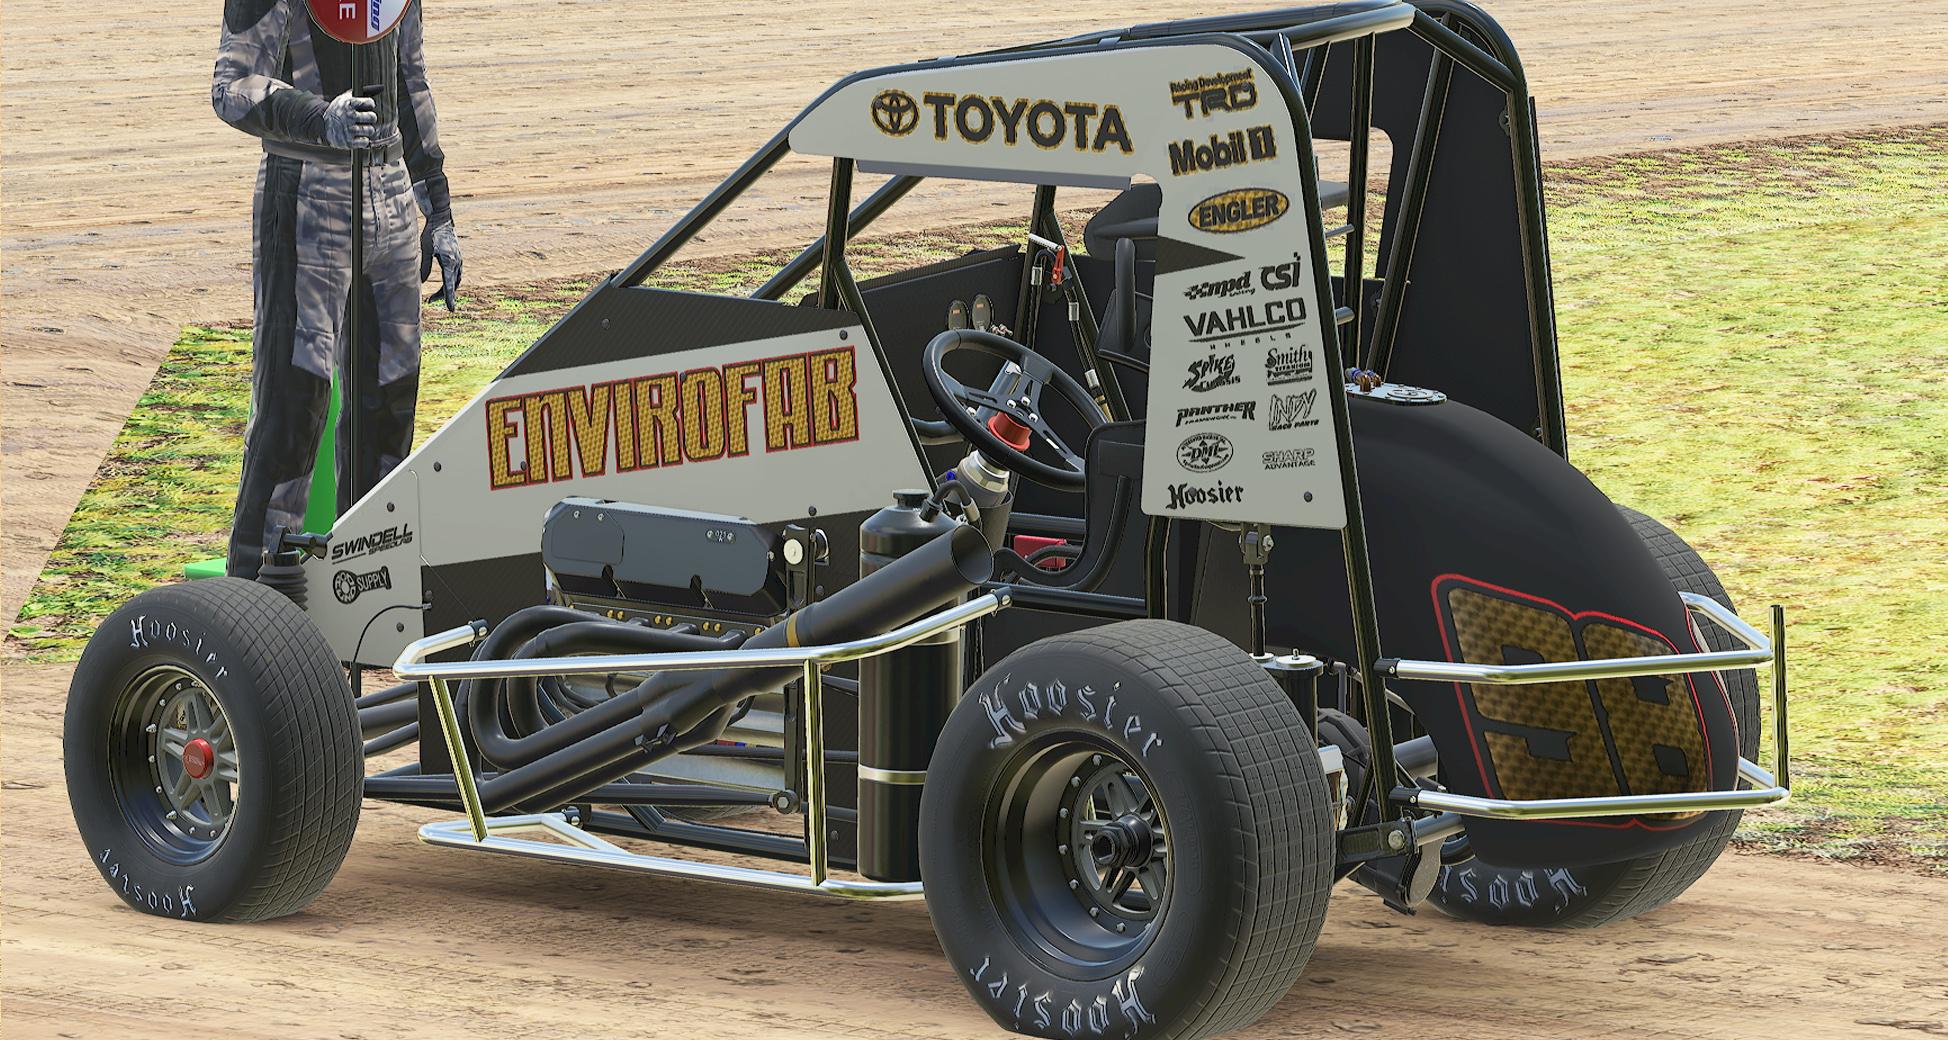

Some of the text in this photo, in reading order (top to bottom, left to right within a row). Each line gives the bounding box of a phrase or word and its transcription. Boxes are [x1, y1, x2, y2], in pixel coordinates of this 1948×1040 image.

[339, 0, 356, 20] E
[1172, 82, 1257, 120] TRD
[923, 91, 1134, 155] TOYOTA
[1168, 125, 1276, 176] Mobil 1
[1199, 195, 1280, 228] ENGLER
[1183, 297, 1307, 337] VAHLCO
[486, 345, 859, 490] ENVIROFAB
[1176, 400, 1256, 427] PANTHER
[1262, 447, 1315, 465] SHARP
[1264, 459, 1316, 471] ADVANTAGE
[1165, 479, 1244, 510] Hoosier
[331, 523, 413, 560] SWINDELL
[356, 570, 388, 592] SUPPLY
[129, 614, 229, 679] Hoosier
[978, 672, 1165, 758] Hoosier
[99, 848, 198, 919] Hoosier
[968, 955, 1157, 1040] Hoosier
